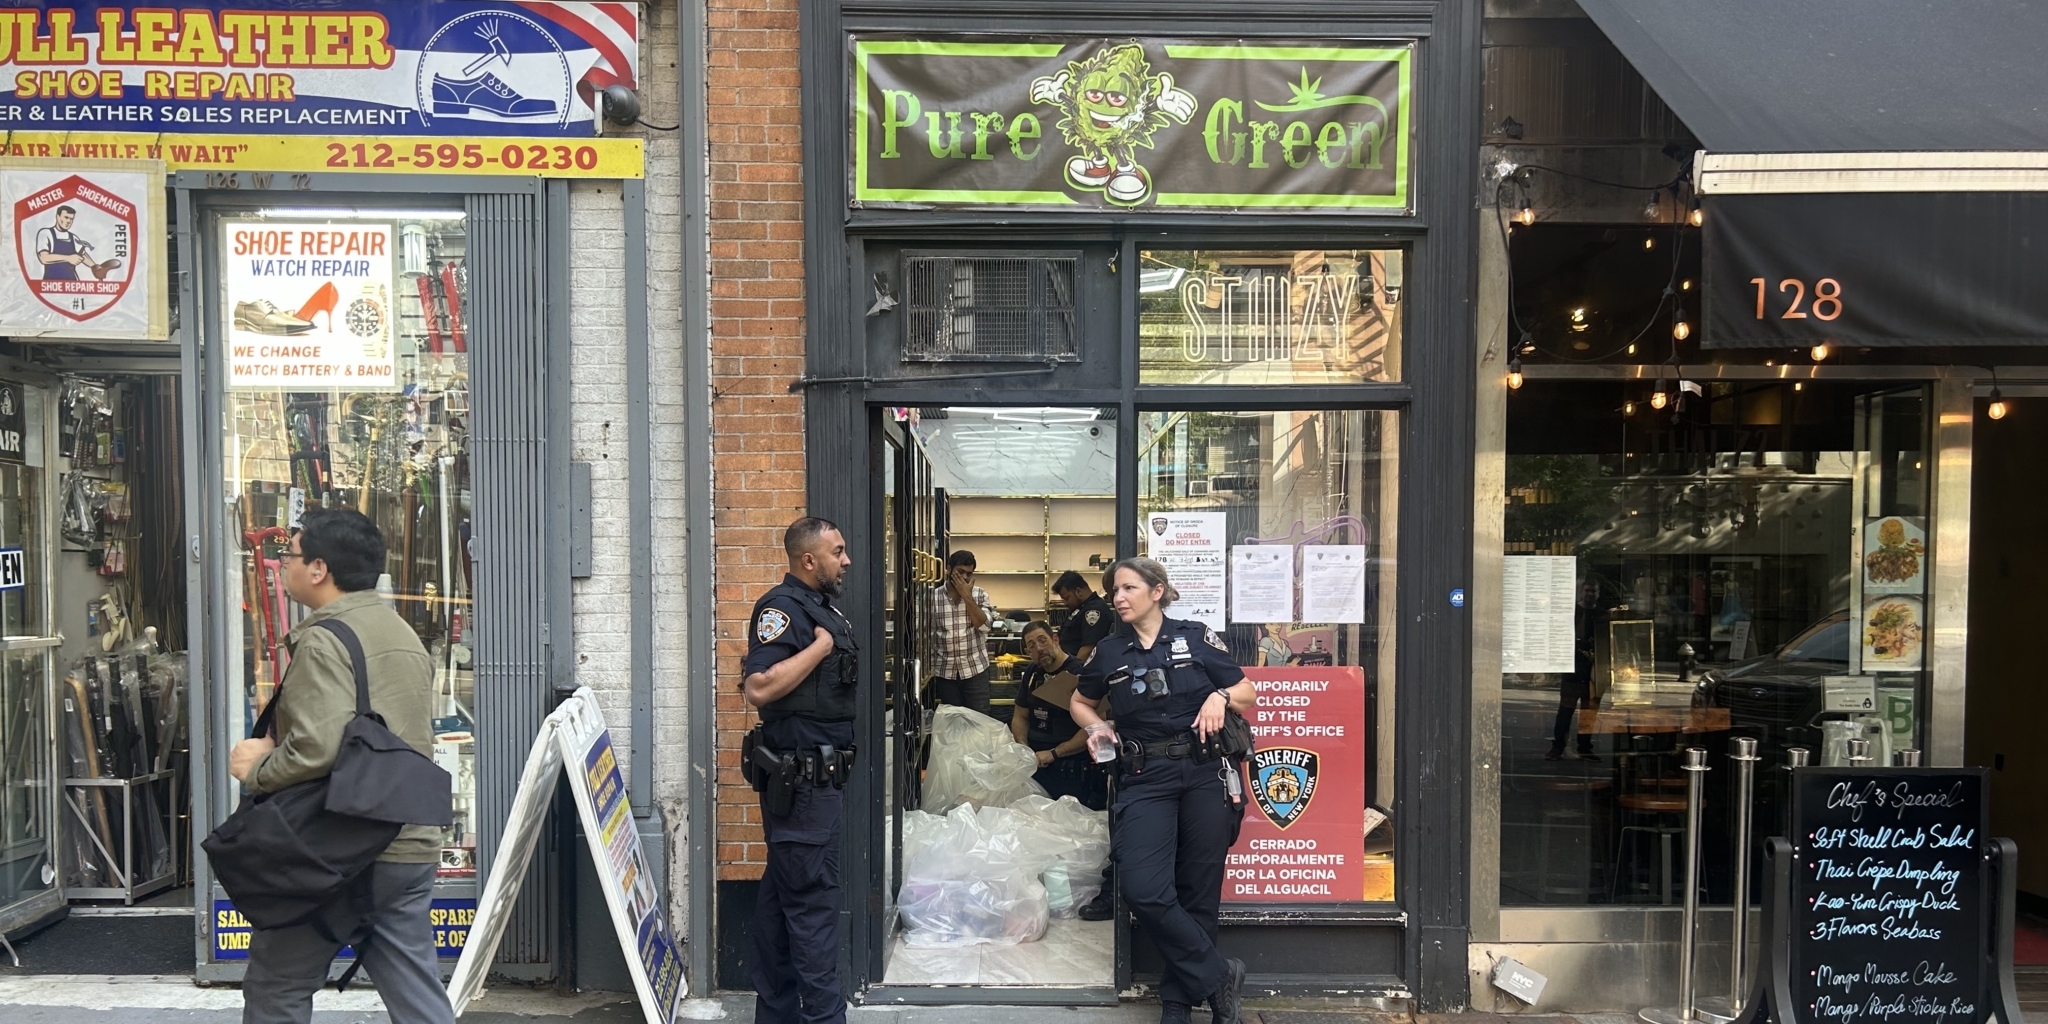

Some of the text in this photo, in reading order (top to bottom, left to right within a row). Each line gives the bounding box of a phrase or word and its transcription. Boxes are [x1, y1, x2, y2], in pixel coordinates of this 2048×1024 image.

[98, 10, 393, 68] LEATHER
[16, 71, 295, 100] SHOE REPAIR
[29, 106, 45, 121] &
[52, 106, 153, 122] LEATHER
[241, 108, 411, 126] REPLACEMENT
[880, 89, 1386, 170] Pure Green
[326, 143, 598, 170] 212-595-0230
[205, 171, 312, 190] 126 W 72
[27, 184, 131, 218] MASTER SHOEMAKER
[114, 224, 127, 258] PETER
[234, 230, 386, 257] SHOE REPAIR
[251, 259, 370, 278] WATCH REPAIR
[41, 281, 120, 293] SHOE REPAIR SHOP
[1749, 277, 1843, 321] 128
[72, 298, 86, 311] #1
[233, 345, 321, 358] WE CHANGE
[233, 364, 392, 377] WATCH BATTERY & BAND
[0, 552, 21, 585] EN
[1256, 695, 1311, 707] CLOSED
[1257, 710, 1306, 722] BY THE
[1887, 695, 1913, 734] B
[1295, 725, 1344, 737] OFFICE
[1255, 749, 1312, 769] SHERIFF
[1251, 778, 1275, 815] CITY OF
[1288, 775, 1316, 821] NEW YORK
[1827, 780, 1965, 822] Chef's Special
[1249, 838, 1317, 850] CERRADO
[1812, 823, 1975, 849] Soft Shell Crab Salad
[1225, 853, 1344, 865] TEMPORALMENTE
[1226, 868, 1336, 880] POR LA OFICINA
[1815, 859, 1854, 881] Thai
[1895, 859, 1961, 895] Dumpling
[1235, 883, 1331, 895] DEL ALGUACIL
[1878, 891, 1922, 919] Crispy
[1921, 890, 1961, 911] Duck
[217, 909, 252, 928] SAL
[1811, 916, 1942, 941] 3 Flavors Seabass
[448, 930, 467, 948] OF
[1511, 971, 1534, 988] NYC
[1864, 962, 1910, 986] Mousse
[1912, 960, 1958, 986] Cake
[1908, 994, 1947, 1024] Sticky
[1949, 996, 1975, 1015] Rice
